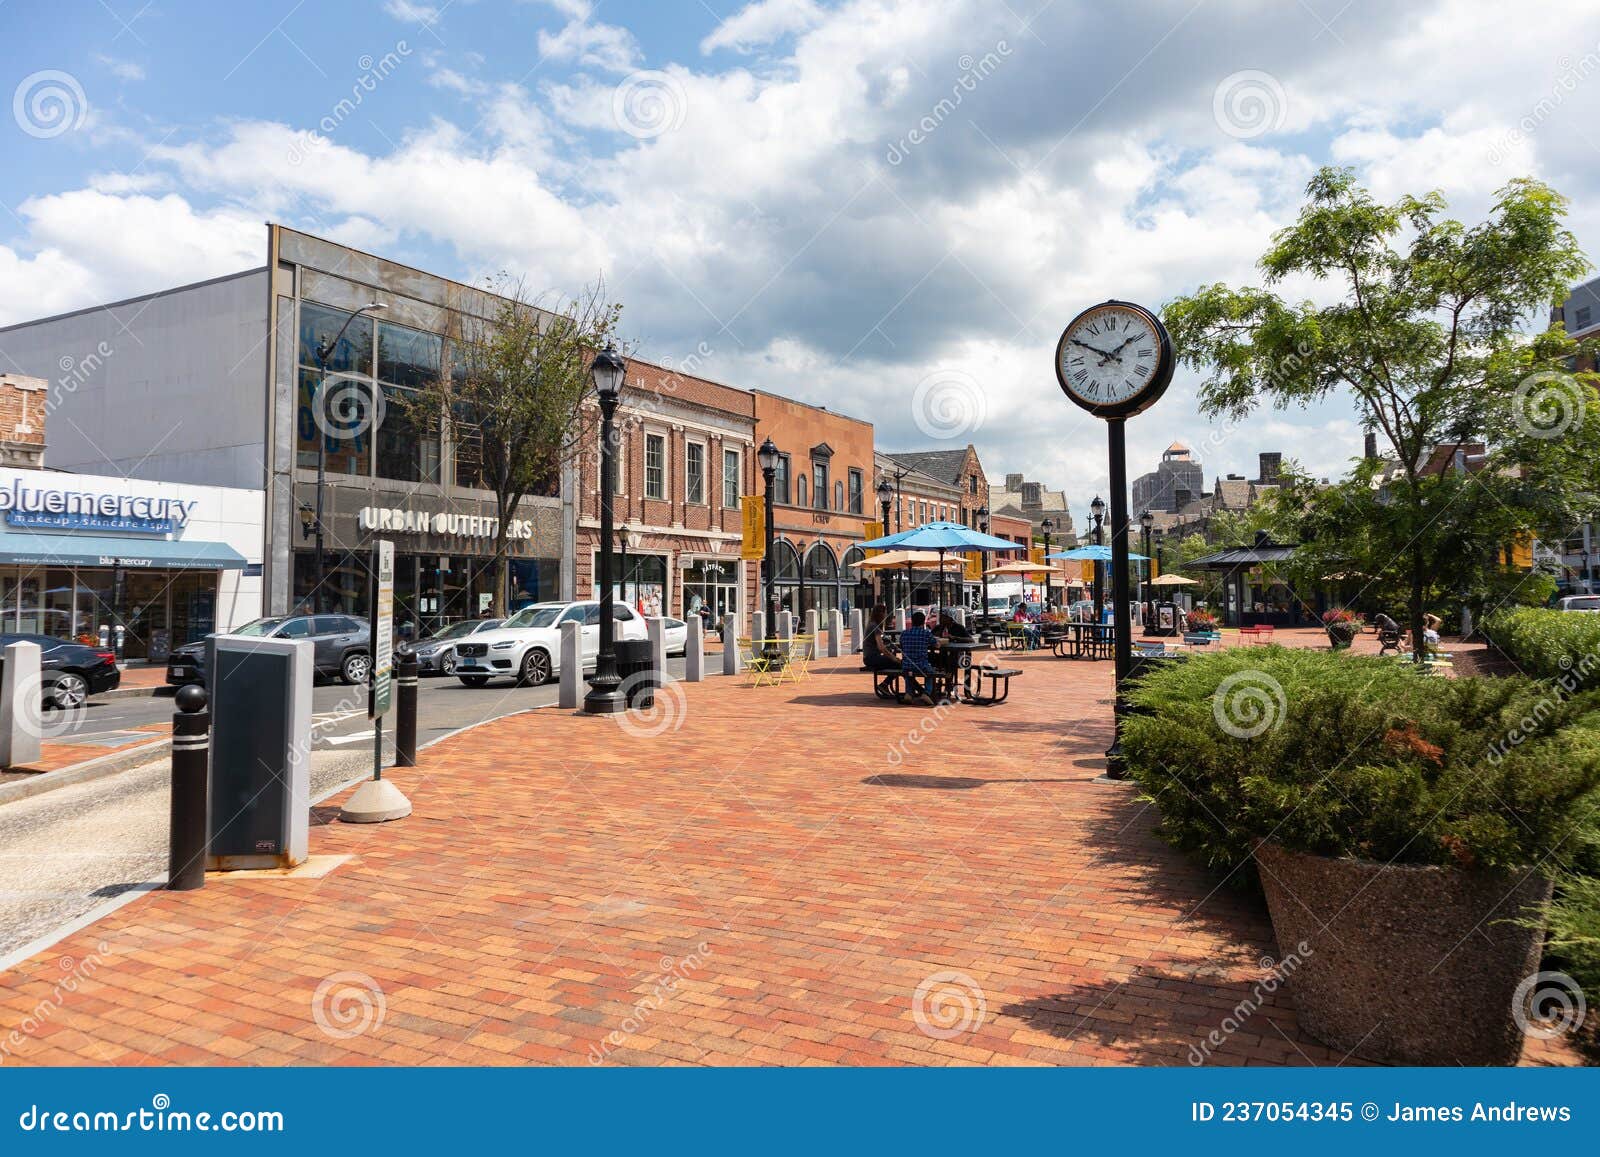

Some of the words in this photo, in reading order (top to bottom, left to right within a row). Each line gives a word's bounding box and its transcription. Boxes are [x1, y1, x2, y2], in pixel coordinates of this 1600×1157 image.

[14, 514, 70, 526] makeup
[82, 518, 138, 529] skincare
[150, 522, 171, 532] spa
[360, 506, 430, 534] URBAN
[99, 556, 153, 568] blumercury
